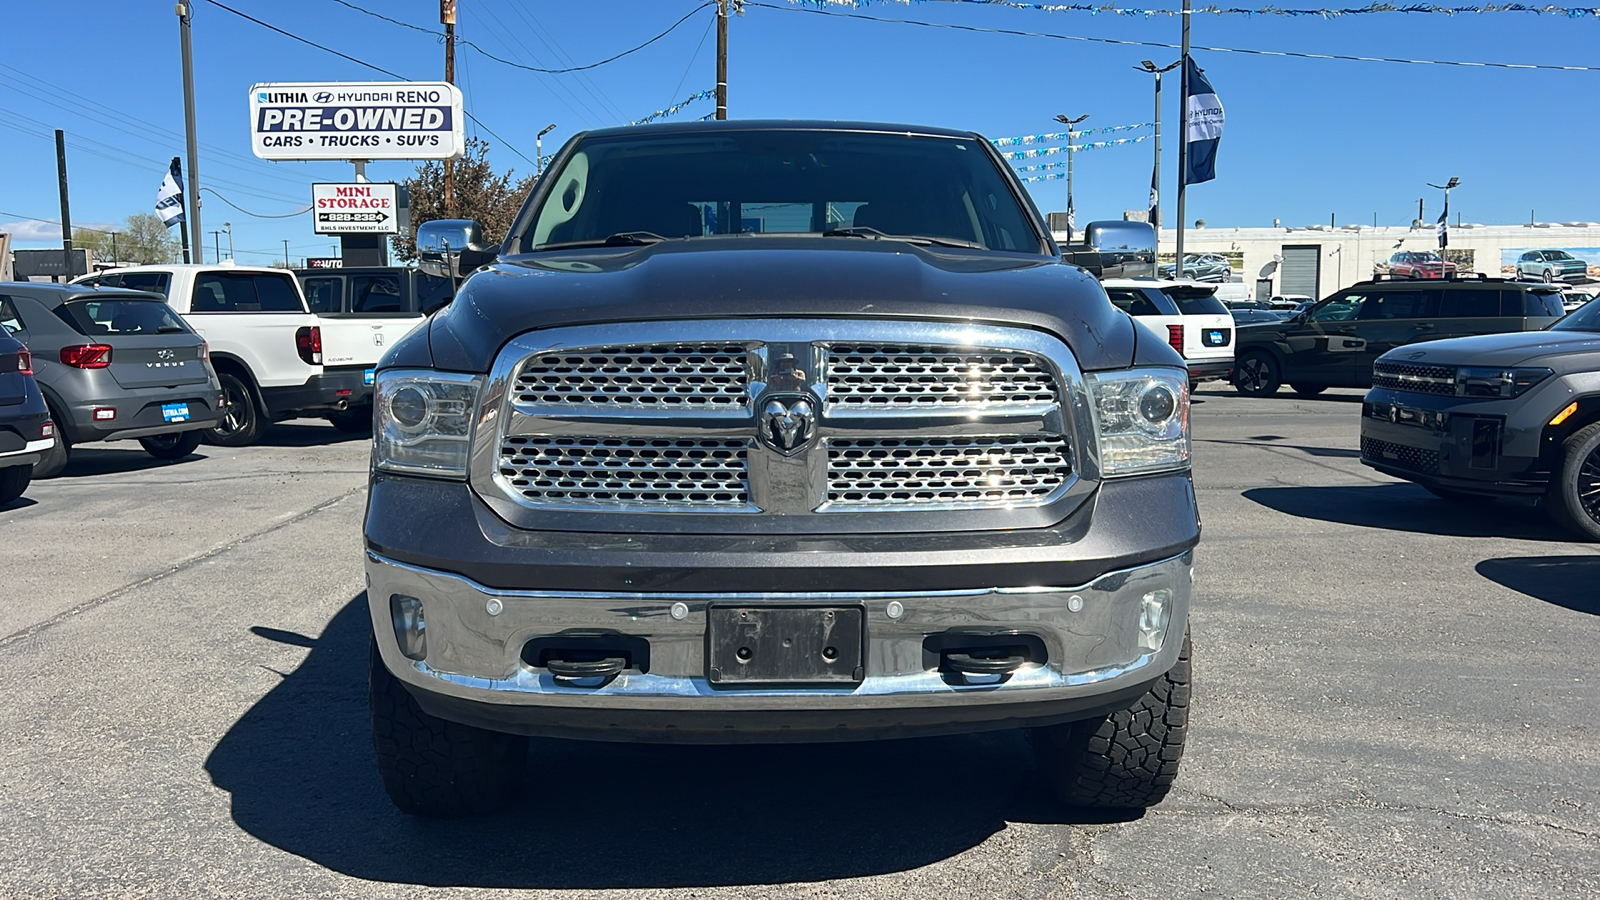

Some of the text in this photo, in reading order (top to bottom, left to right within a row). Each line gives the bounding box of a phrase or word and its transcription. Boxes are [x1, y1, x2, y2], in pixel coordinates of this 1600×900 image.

[268, 91, 440, 103] LITHIA HYUNDAI RENO
[262, 108, 444, 131] PRE-OWNED
[262, 135, 439, 147] CARS TRUCKS SUV'S
[336, 187, 371, 197] MINI
[318, 198, 390, 209] STORAGE
